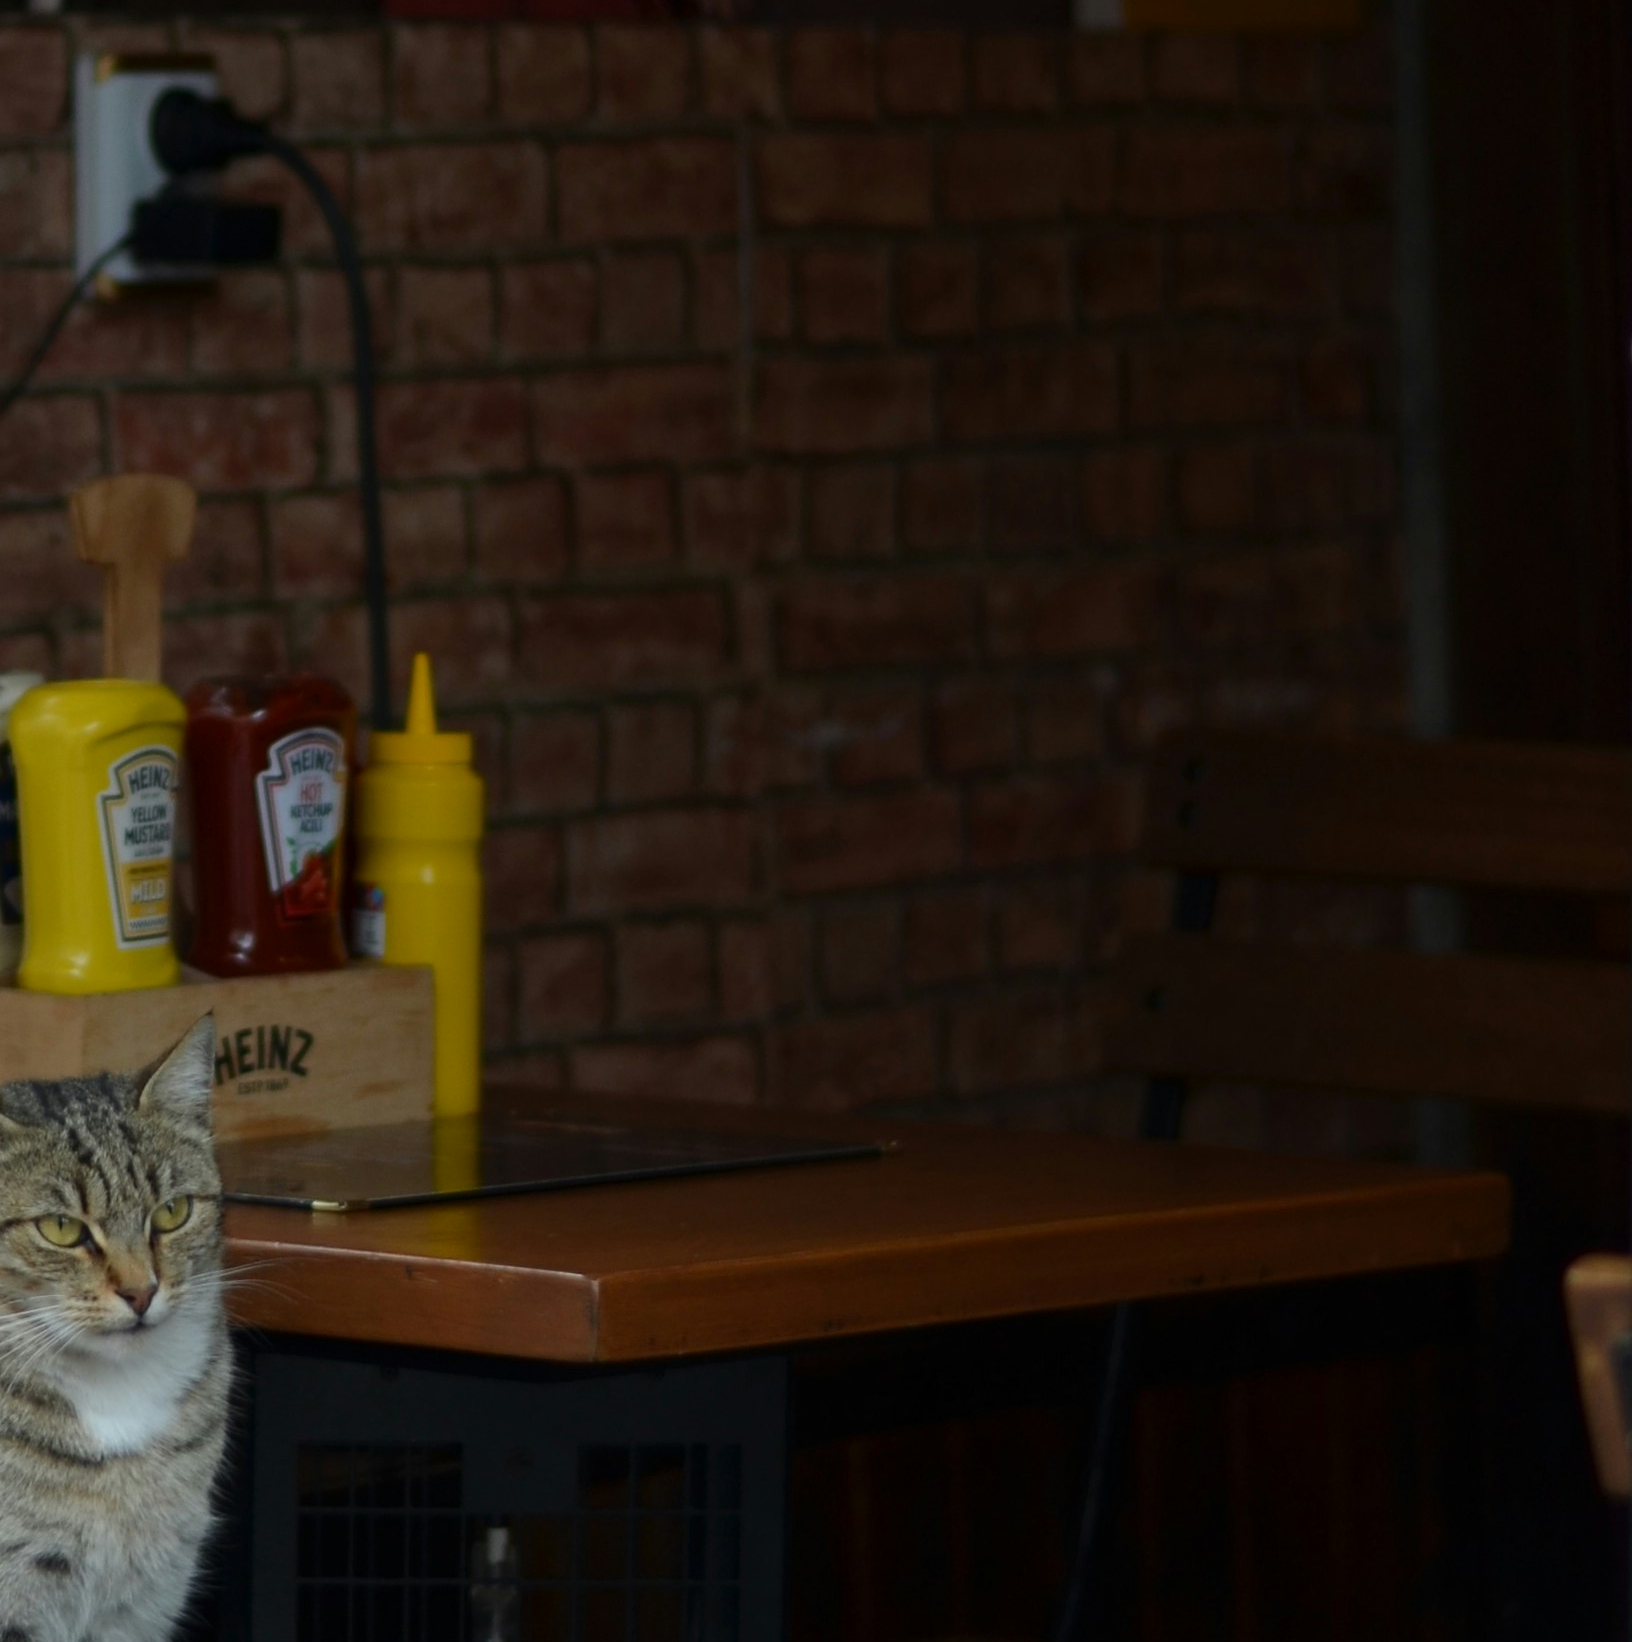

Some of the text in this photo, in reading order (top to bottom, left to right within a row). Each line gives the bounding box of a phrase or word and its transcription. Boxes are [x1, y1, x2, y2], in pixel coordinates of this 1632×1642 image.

[290, 748, 334, 775] HEINZ
[128, 765, 171, 794] HEINZ
[299, 782, 322, 800] HOT
[131, 804, 167, 823] YELLOW
[124, 823, 172, 846] MUSTARD
[214, 1024, 314, 1086] HEINZ
